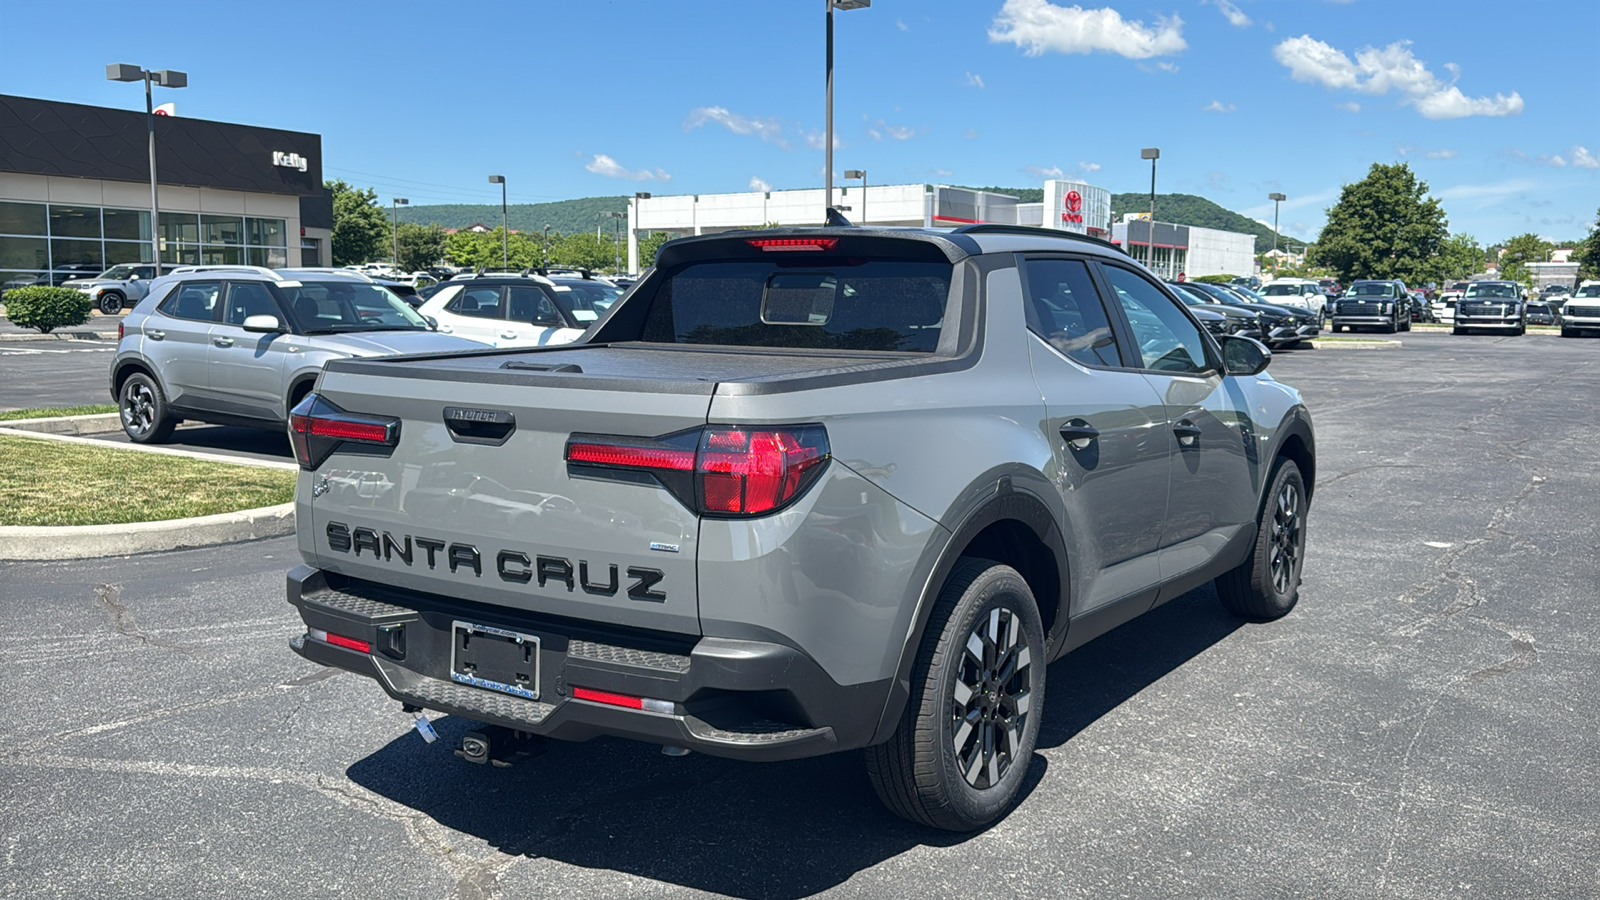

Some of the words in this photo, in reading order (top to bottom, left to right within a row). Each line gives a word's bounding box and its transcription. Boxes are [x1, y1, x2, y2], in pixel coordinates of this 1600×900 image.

[273, 151, 307, 172] Kelly
[1061, 212, 1083, 223] TOYOTA
[451, 410, 497, 422] HYUNDAI
[326, 520, 482, 577] SANTA
[497, 549, 666, 603] CRUZ
[472, 623, 518, 637] Kellycar.com
[480, 680, 502, 691] Auto
